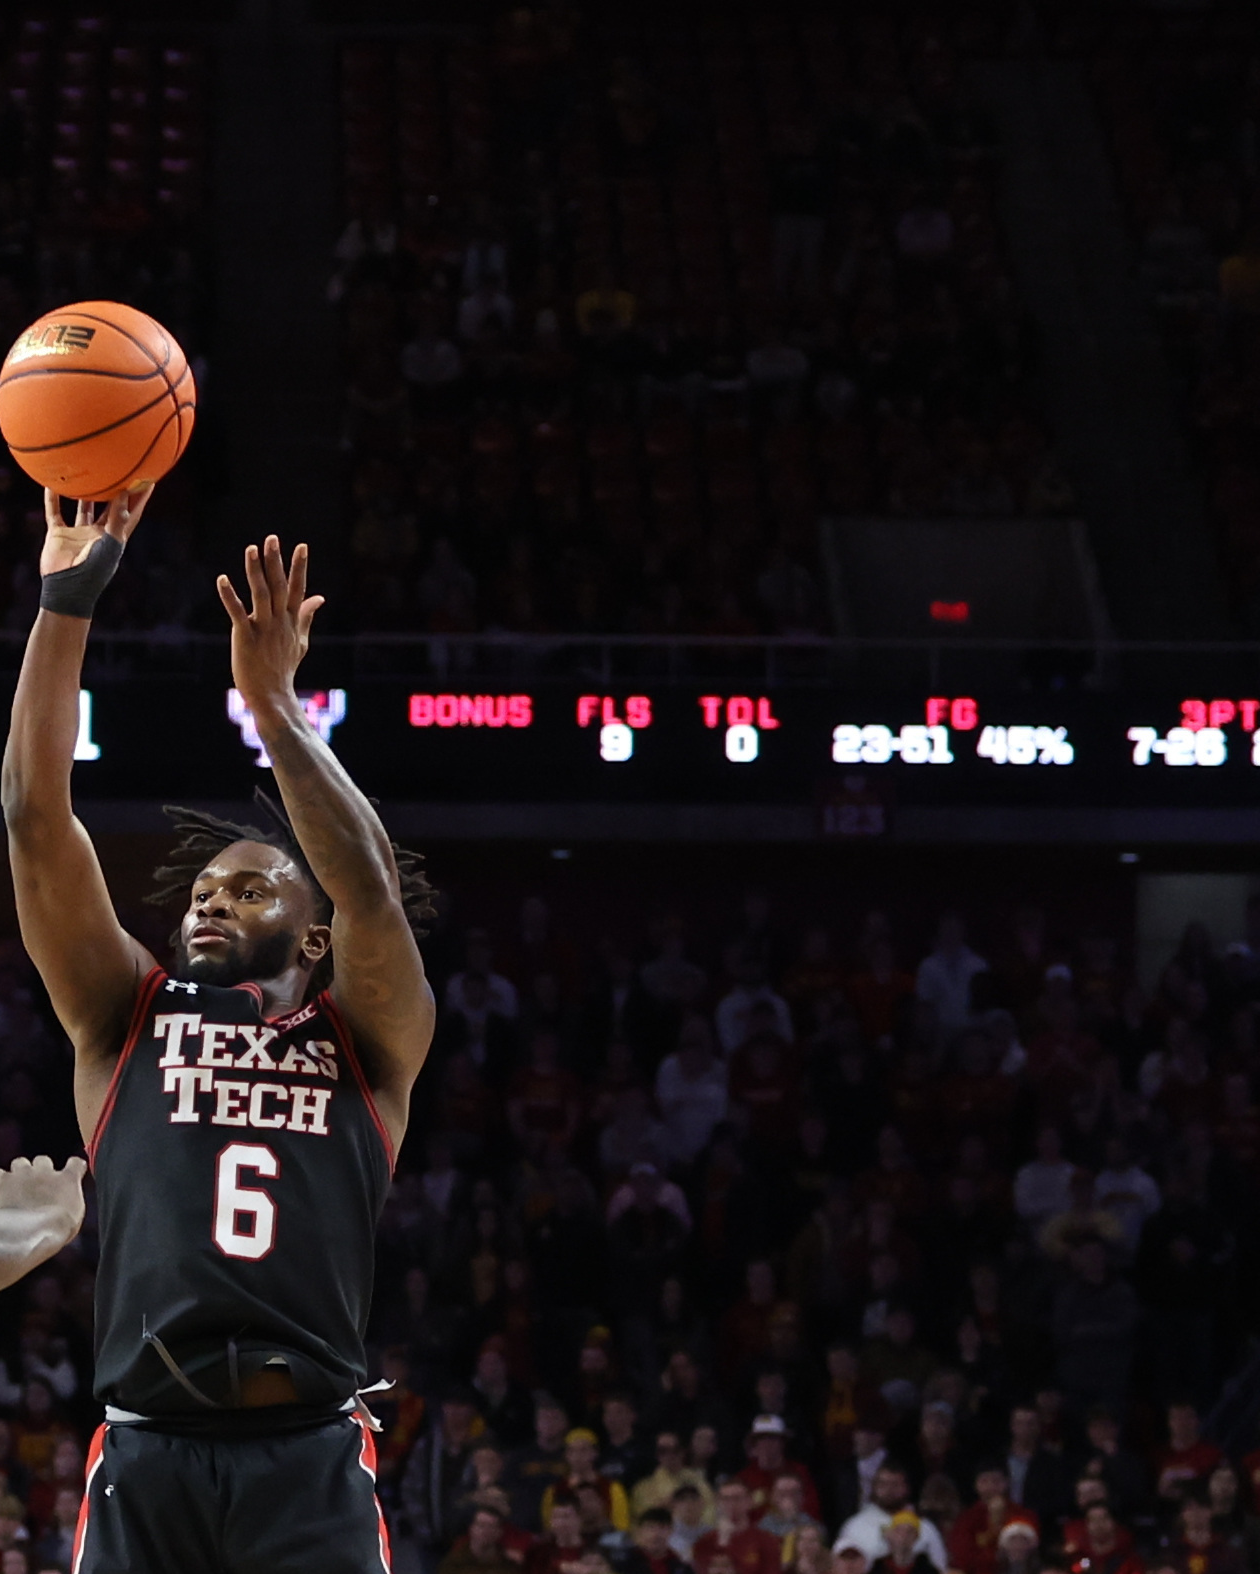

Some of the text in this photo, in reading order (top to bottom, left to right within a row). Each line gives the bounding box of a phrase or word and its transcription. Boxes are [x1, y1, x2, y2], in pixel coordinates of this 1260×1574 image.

[409, 694, 532, 727] BONUS
[577, 695, 652, 728] FLS
[699, 696, 780, 729] TOL
[926, 697, 979, 731] FG
[600, 724, 633, 762] 9
[725, 725, 758, 763] 0
[832, 724, 1075, 765] 23-51 45%
[153, 1013, 339, 1081] TEXAS
[162, 1067, 332, 1136] TECH
[211, 1141, 280, 1262] 6
